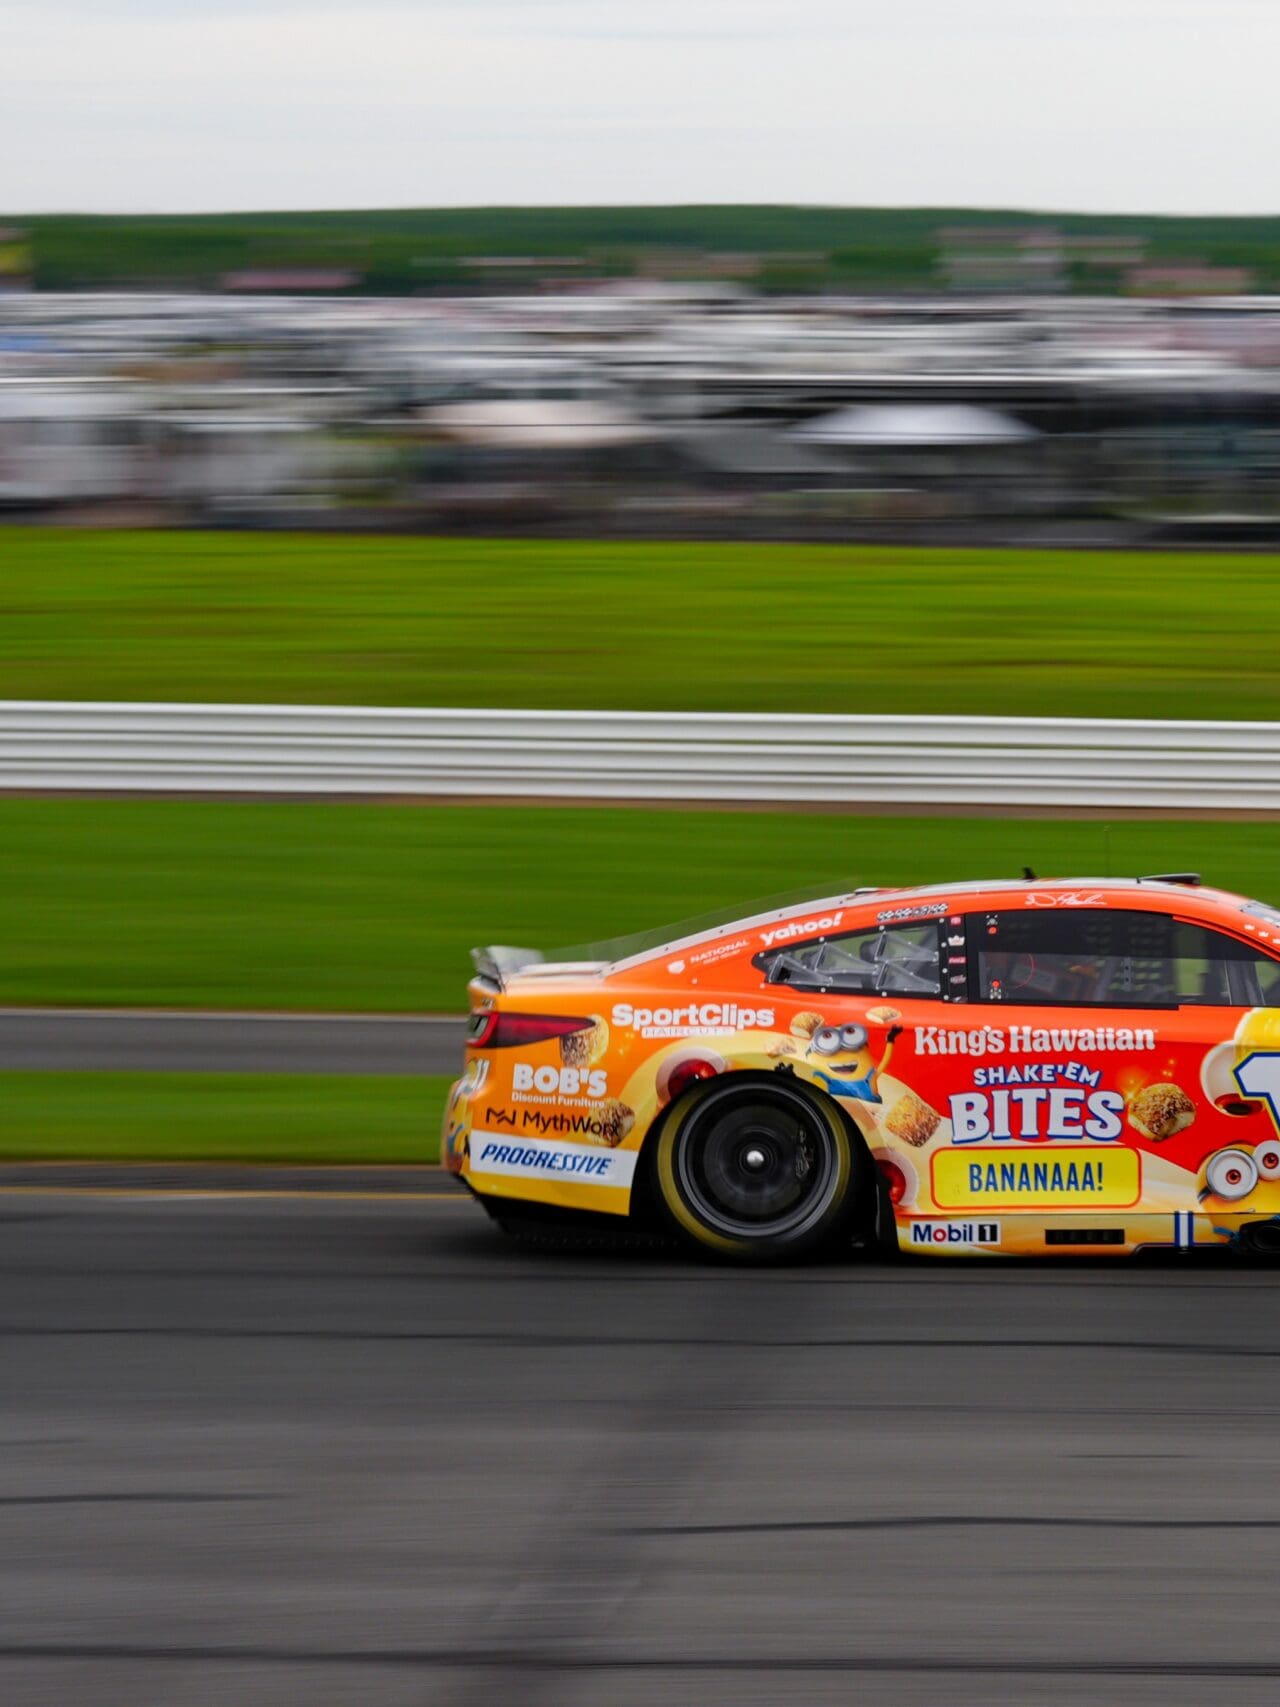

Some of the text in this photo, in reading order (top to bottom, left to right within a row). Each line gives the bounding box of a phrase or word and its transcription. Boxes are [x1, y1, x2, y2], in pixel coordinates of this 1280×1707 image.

[760, 912, 844, 946] yahoo!
[690, 939, 750, 964] NATIONAL
[612, 1003, 775, 1030] SportClips
[915, 1026, 1156, 1056] King's Hawaiian
[512, 1063, 608, 1097] BOB'S
[511, 1091, 605, 1109] Discount Furniture
[949, 1088, 1125, 1144] BITES
[481, 1143, 612, 1175] PROGRESSIVE
[969, 1162, 1103, 1192] BANANAAA!
[913, 1224, 973, 1243] Mobil
